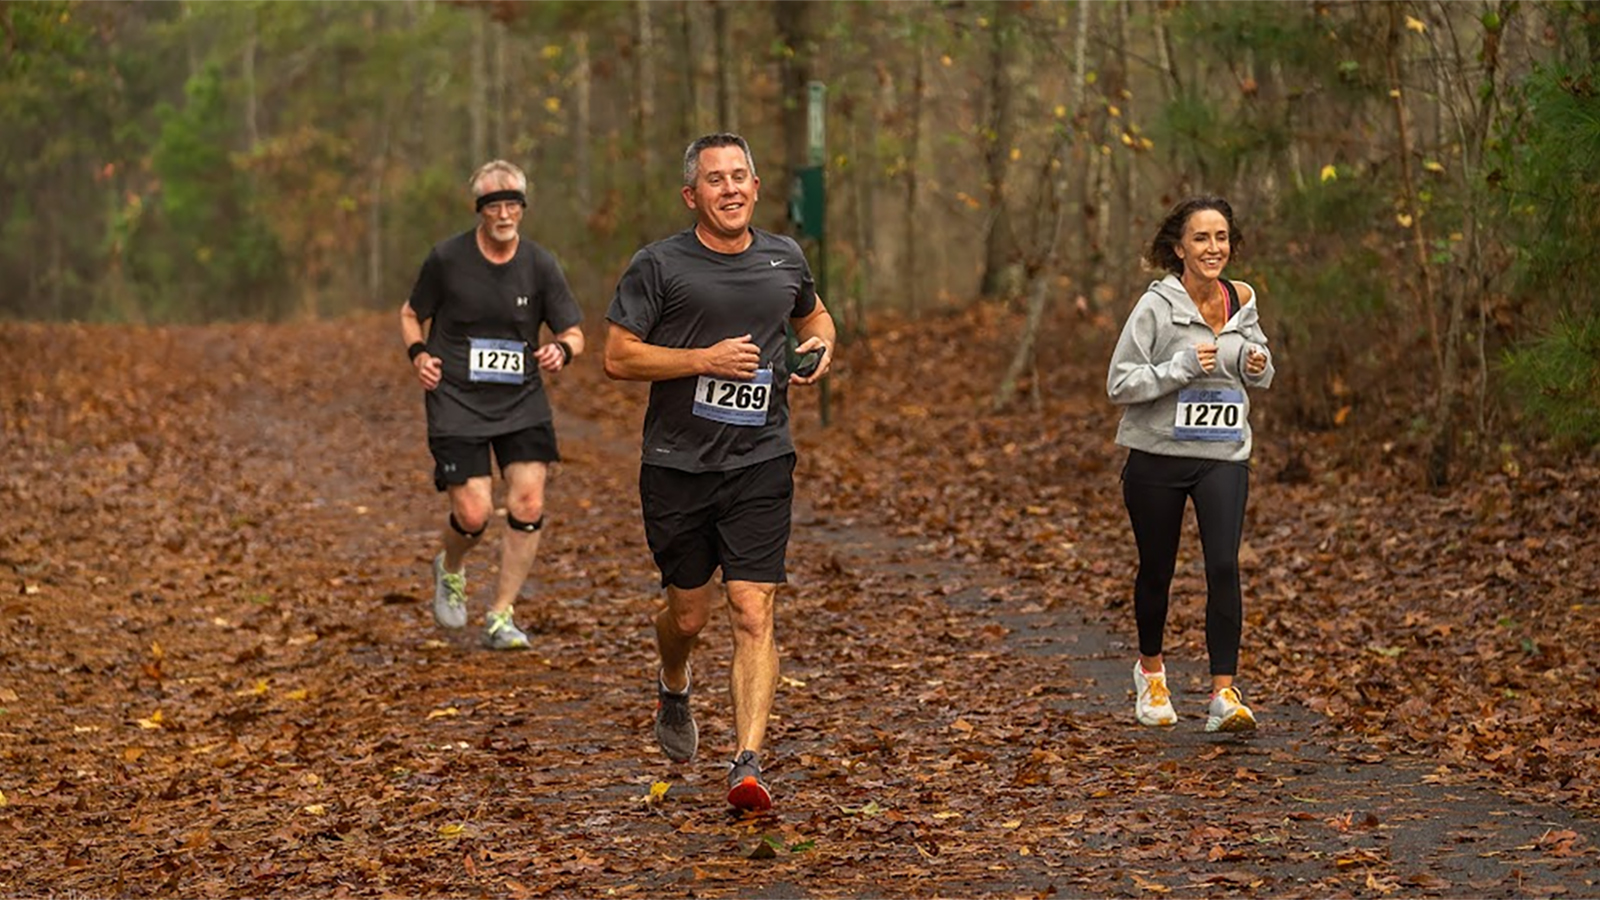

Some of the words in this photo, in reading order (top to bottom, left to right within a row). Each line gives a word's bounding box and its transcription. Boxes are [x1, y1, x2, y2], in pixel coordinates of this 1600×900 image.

[478, 351, 520, 372] 1273
[705, 380, 767, 410] 1269
[1184, 404, 1239, 427] 1270
